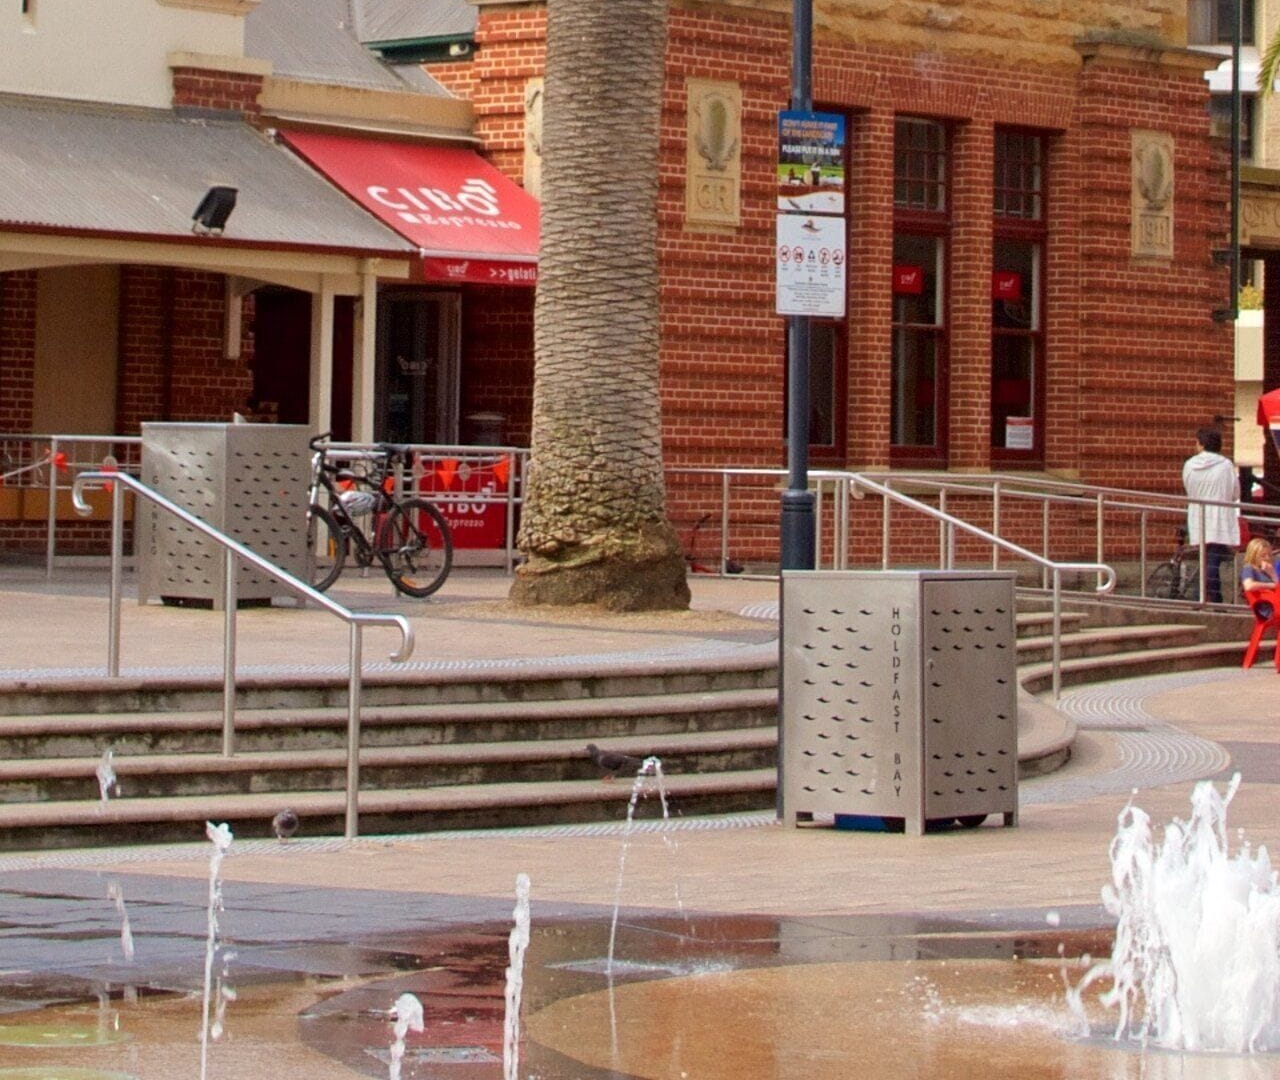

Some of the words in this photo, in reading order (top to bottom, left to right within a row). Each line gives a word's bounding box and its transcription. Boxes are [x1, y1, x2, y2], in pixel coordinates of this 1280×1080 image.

[366, 184, 500, 216] CIBO
[1243, 201, 1268, 228] OST
[418, 213, 522, 230] Espresso
[891, 607, 902, 734] HOLDFAST
[893, 752, 902, 797] BAY
